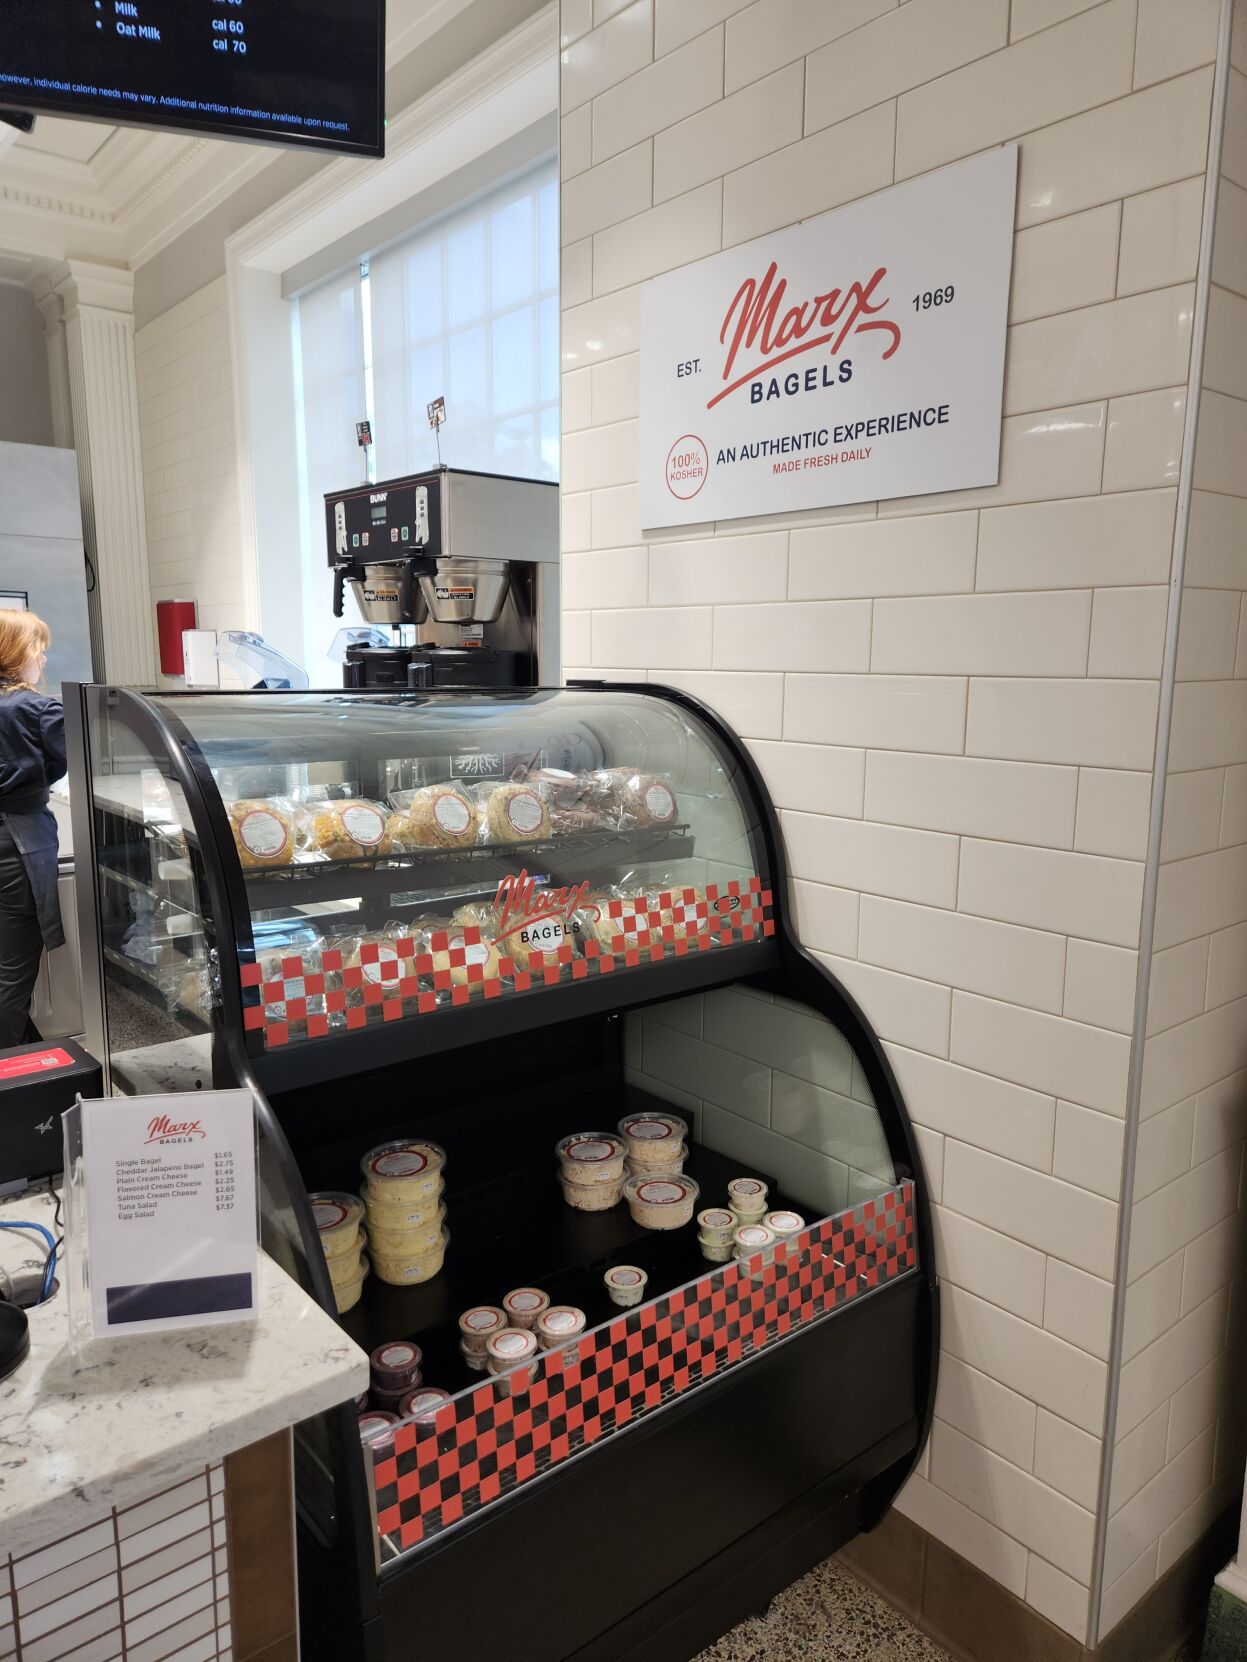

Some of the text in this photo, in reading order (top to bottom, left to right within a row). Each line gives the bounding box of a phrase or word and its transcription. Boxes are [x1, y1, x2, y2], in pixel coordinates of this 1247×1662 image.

[115, 1, 138, 18] Milk
[116, 22, 161, 41] Oat Milk
[212, 19, 244, 34] cal 60
[213, 38, 247, 54] cal 70
[33, 76, 71, 91] individual
[72, 82, 98, 95] calorie
[99, 87, 121, 98] needs
[122, 91, 139, 102] may
[140, 93, 158, 104] vary.
[160, 95, 197, 110] Additional
[198, 100, 229, 114] nutrition
[230, 105, 271, 120] information
[272, 111, 302, 125] available
[303, 117, 322, 128] upon
[322, 120, 350, 132] request.
[911, 285, 955, 313] 1969
[707, 261, 900, 396] Marx
[677, 358, 702, 378] EST.
[750, 358, 853, 404] BAGELS
[716, 404, 950, 466] AN AUTHENTIC EXPERIENCE
[671, 450, 701, 470] 100%
[772, 446, 873, 475] MADE FRESH DAILY
[670, 467, 704, 482] KOSHER
[370, 492, 388, 504] BUNN
[491, 868, 601, 938] Marx
[520, 921, 580, 943] BAGELS
[144, 1114, 205, 1141] Marx
[159, 1137, 193, 1145] BAGELS
[115, 1157, 162, 1167] Single Bagel
[214, 1151, 233, 1159] $1.65
[116, 1166, 148, 1176] Cheddar
[183, 1162, 205, 1170] Bagel
[215, 1168, 234, 1176] $1.49
[116, 1176, 135, 1184] Plain
[117, 1180, 202, 1193] Flavored Cream Cheese
[117, 1189, 198, 1202] Salmon Cream Cheese
[118, 1201, 158, 1211] Tuna Salad
[118, 1210, 155, 1220] Egg Salad
